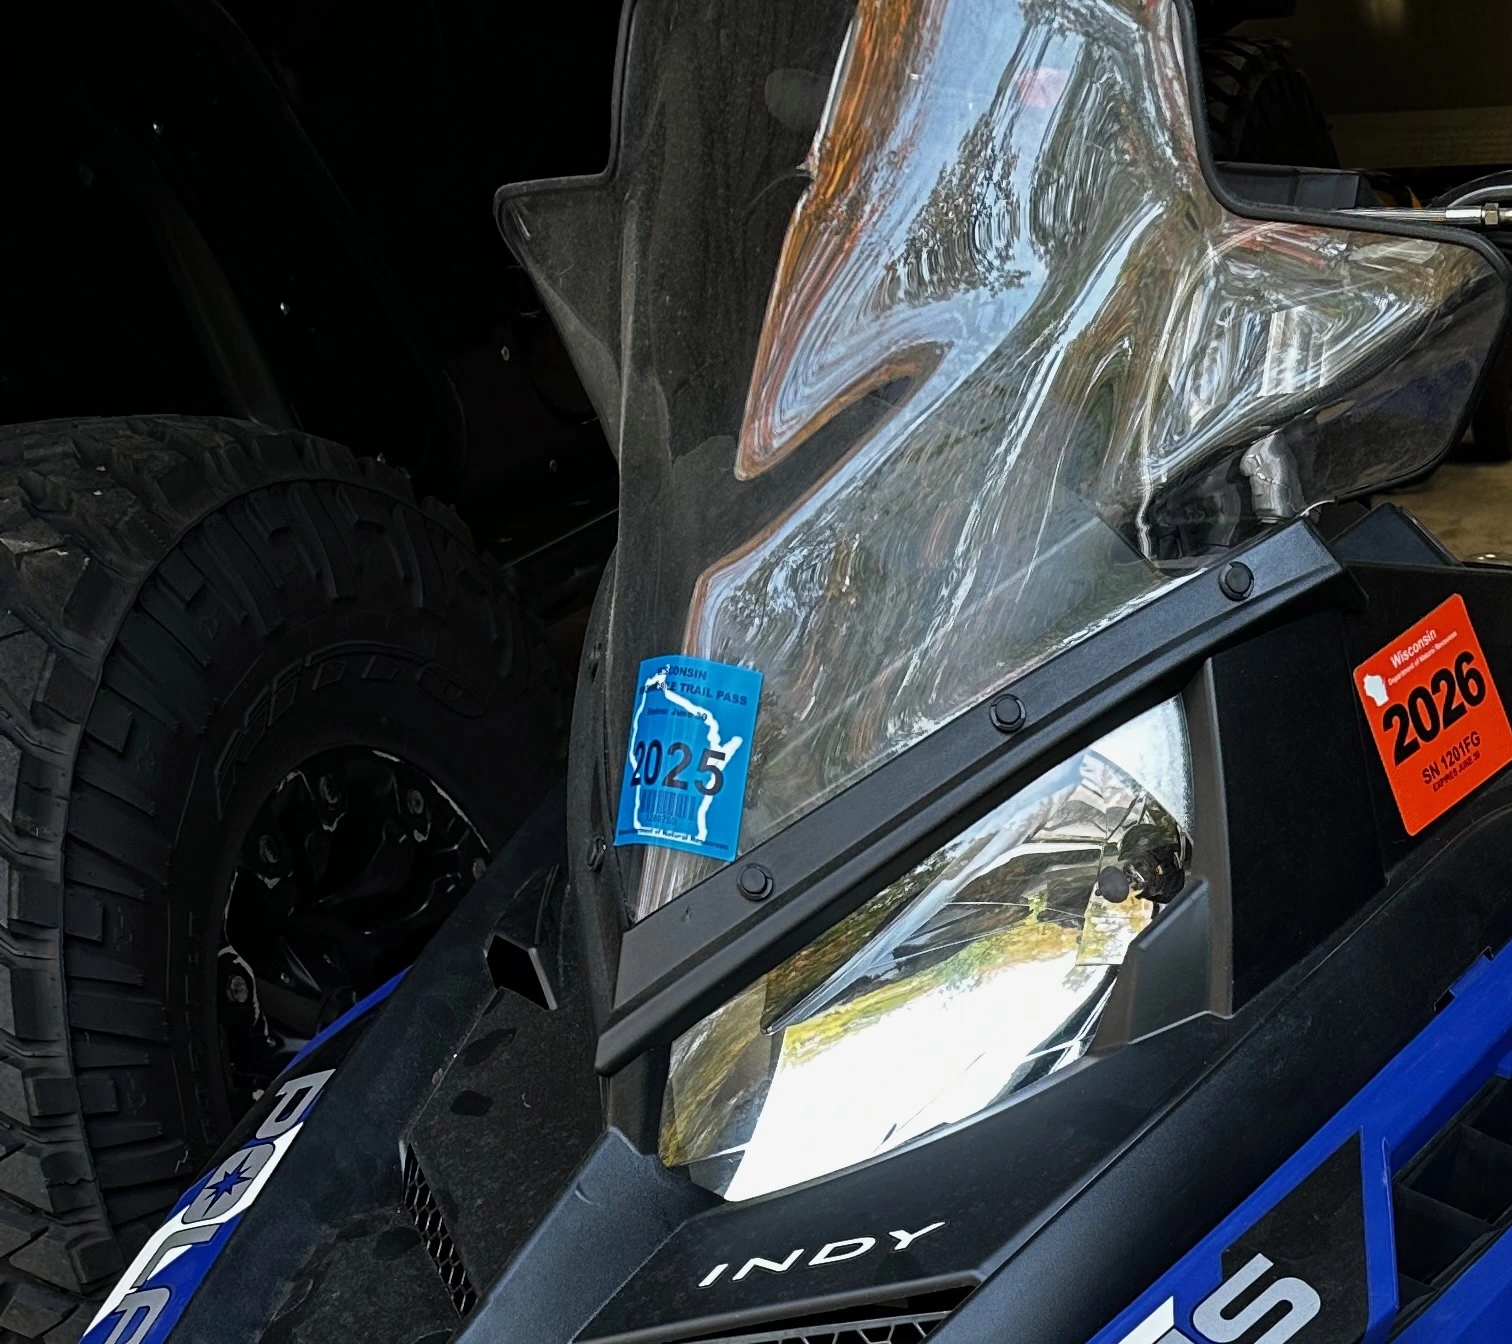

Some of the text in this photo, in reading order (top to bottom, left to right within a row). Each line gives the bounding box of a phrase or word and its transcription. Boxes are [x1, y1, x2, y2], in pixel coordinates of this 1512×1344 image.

[657, 664, 708, 681] CONSIN
[1389, 628, 1438, 670] Wisconsin
[680, 682, 714, 699] TRAIL
[716, 690, 748, 706] PASS
[1383, 651, 1487, 768] 2026
[630, 738, 726, 797] 2025
[1421, 730, 1482, 786] SN 1201FG
[698, 1221, 946, 1288] INDY
